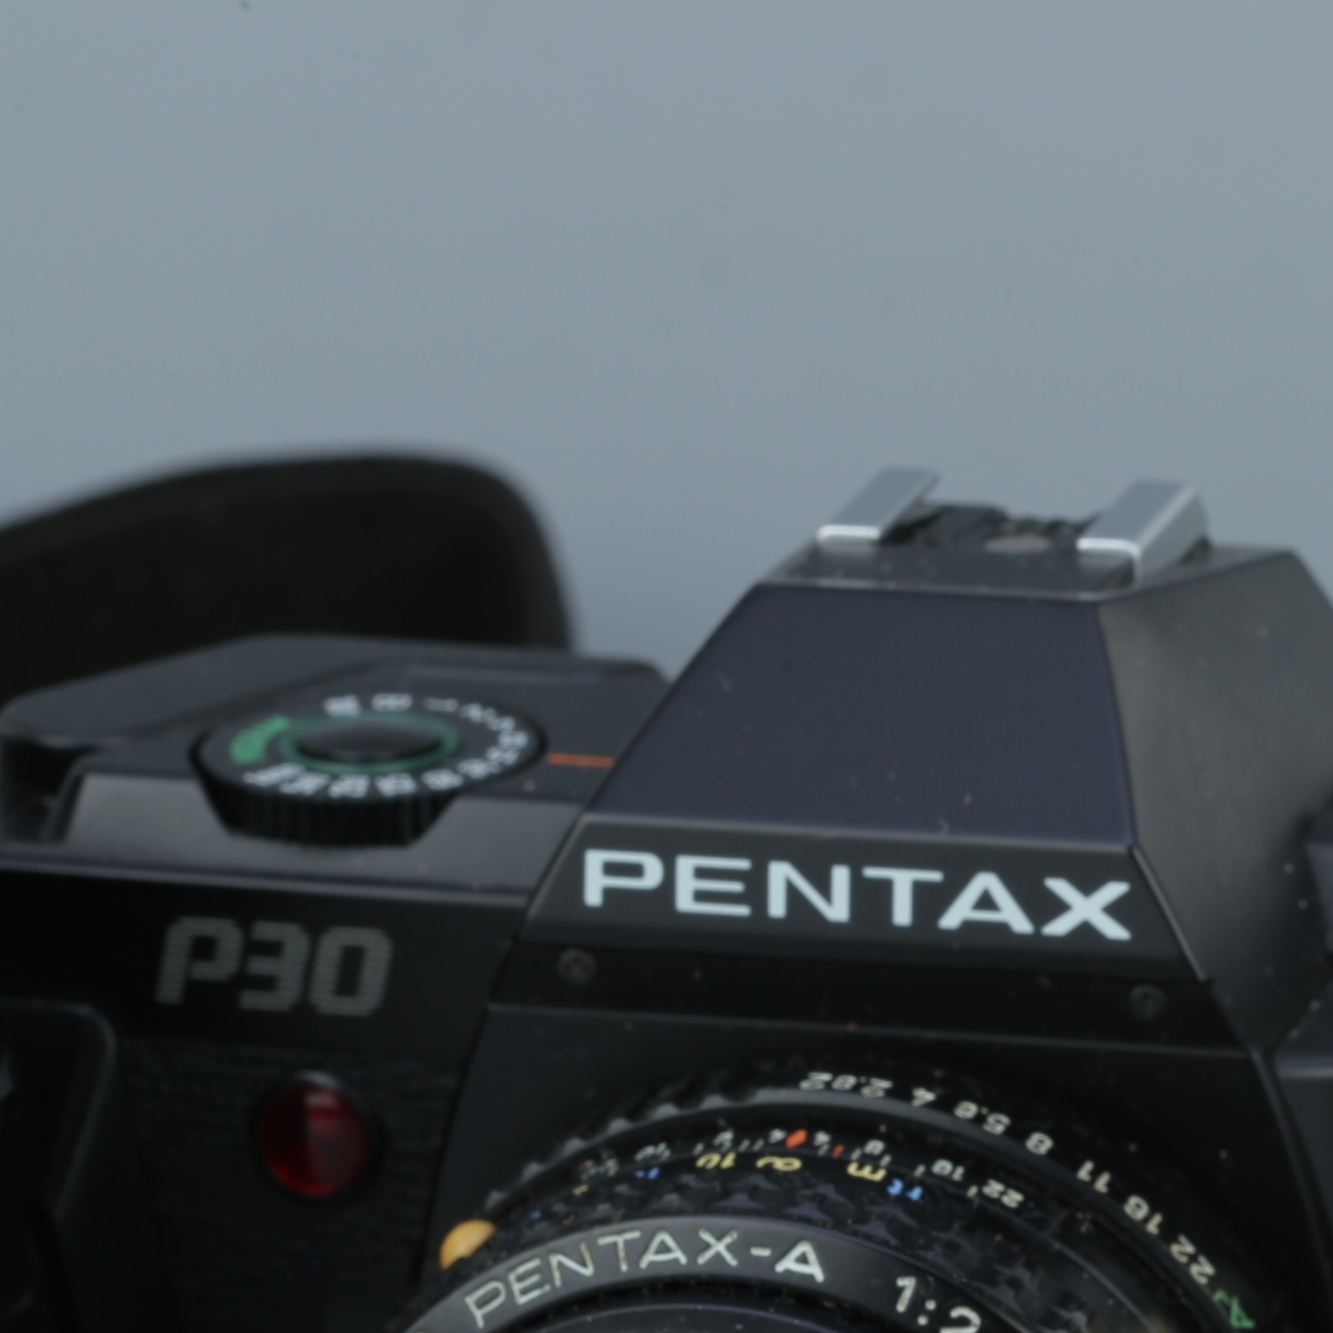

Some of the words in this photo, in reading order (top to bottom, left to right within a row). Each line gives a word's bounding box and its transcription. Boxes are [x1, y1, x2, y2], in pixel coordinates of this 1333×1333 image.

[580, 846, 1134, 943] PENTAX
[154, 915, 393, 1017] P30
[1075, 1159, 1112, 1195] 11
[464, 1228, 826, 1329] PENTAX-A
[1169, 1232, 1217, 1286] 22
